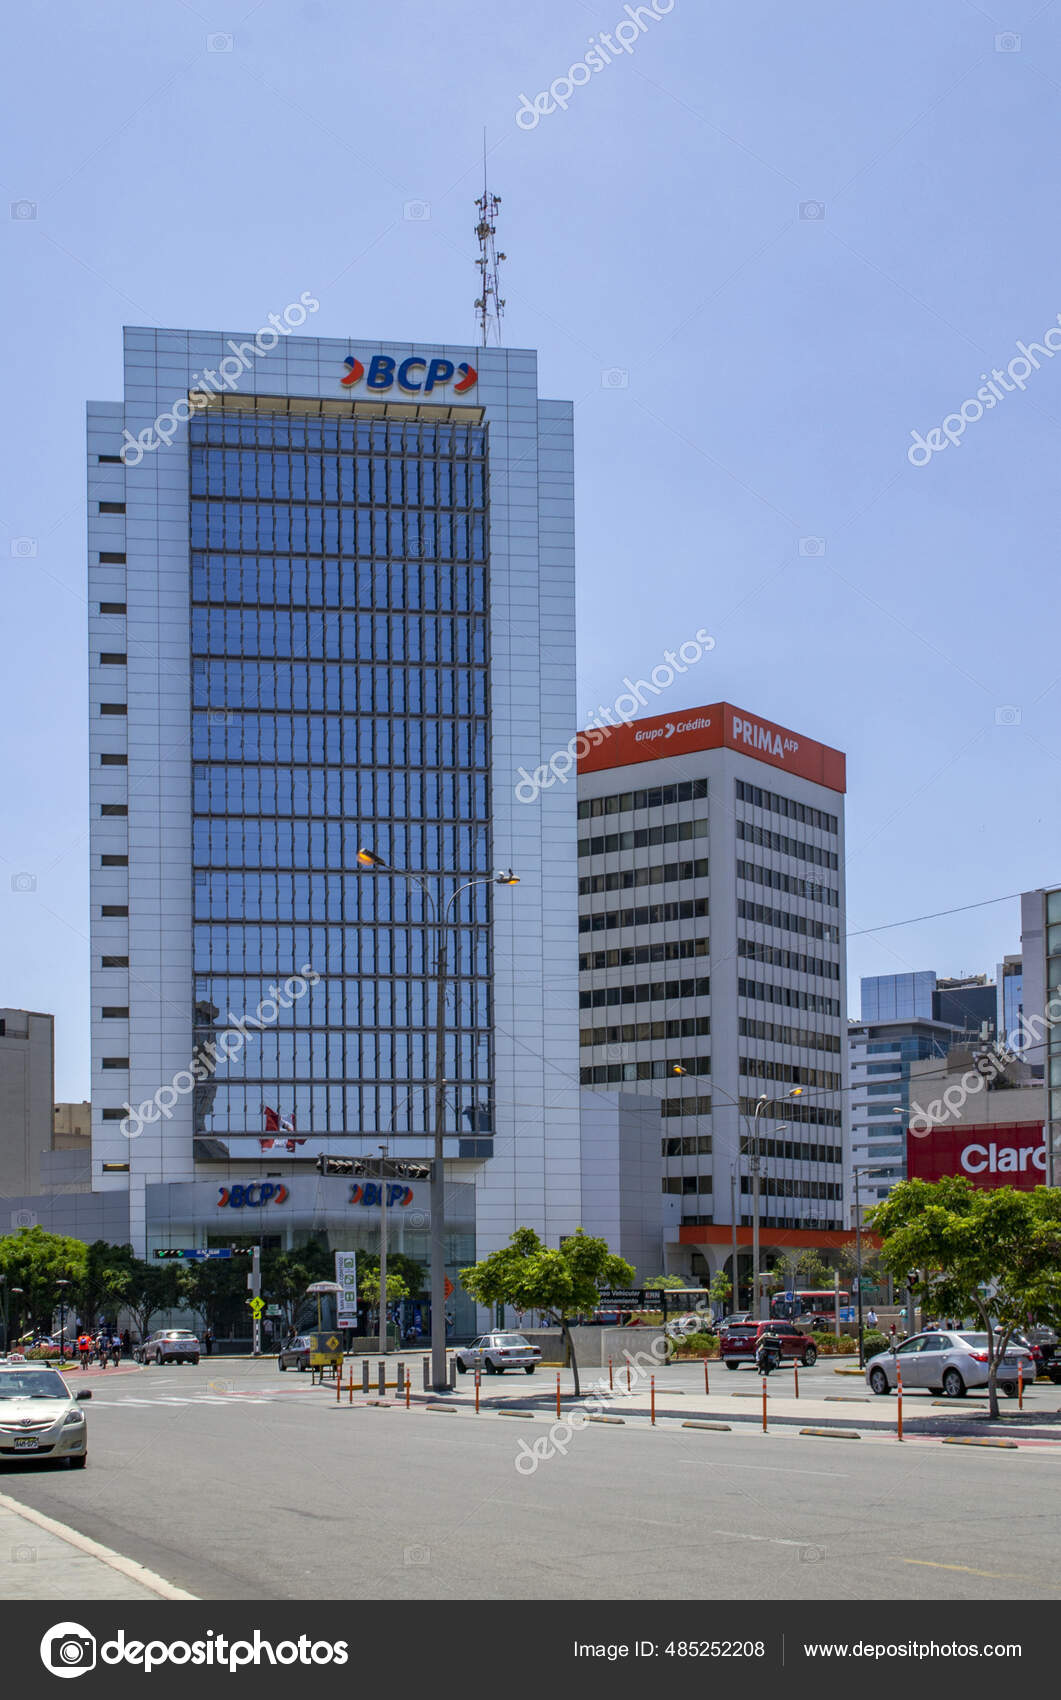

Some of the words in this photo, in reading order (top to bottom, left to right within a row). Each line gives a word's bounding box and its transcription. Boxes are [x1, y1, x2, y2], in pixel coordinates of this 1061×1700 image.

[366, 355, 455, 395] BCP
[635, 727, 664, 742] Grupo
[676, 718, 711, 734] Crédito
[733, 716, 784, 759] PRIMA
[784, 737, 799, 753] AFP
[229, 1182, 275, 1208] BCP
